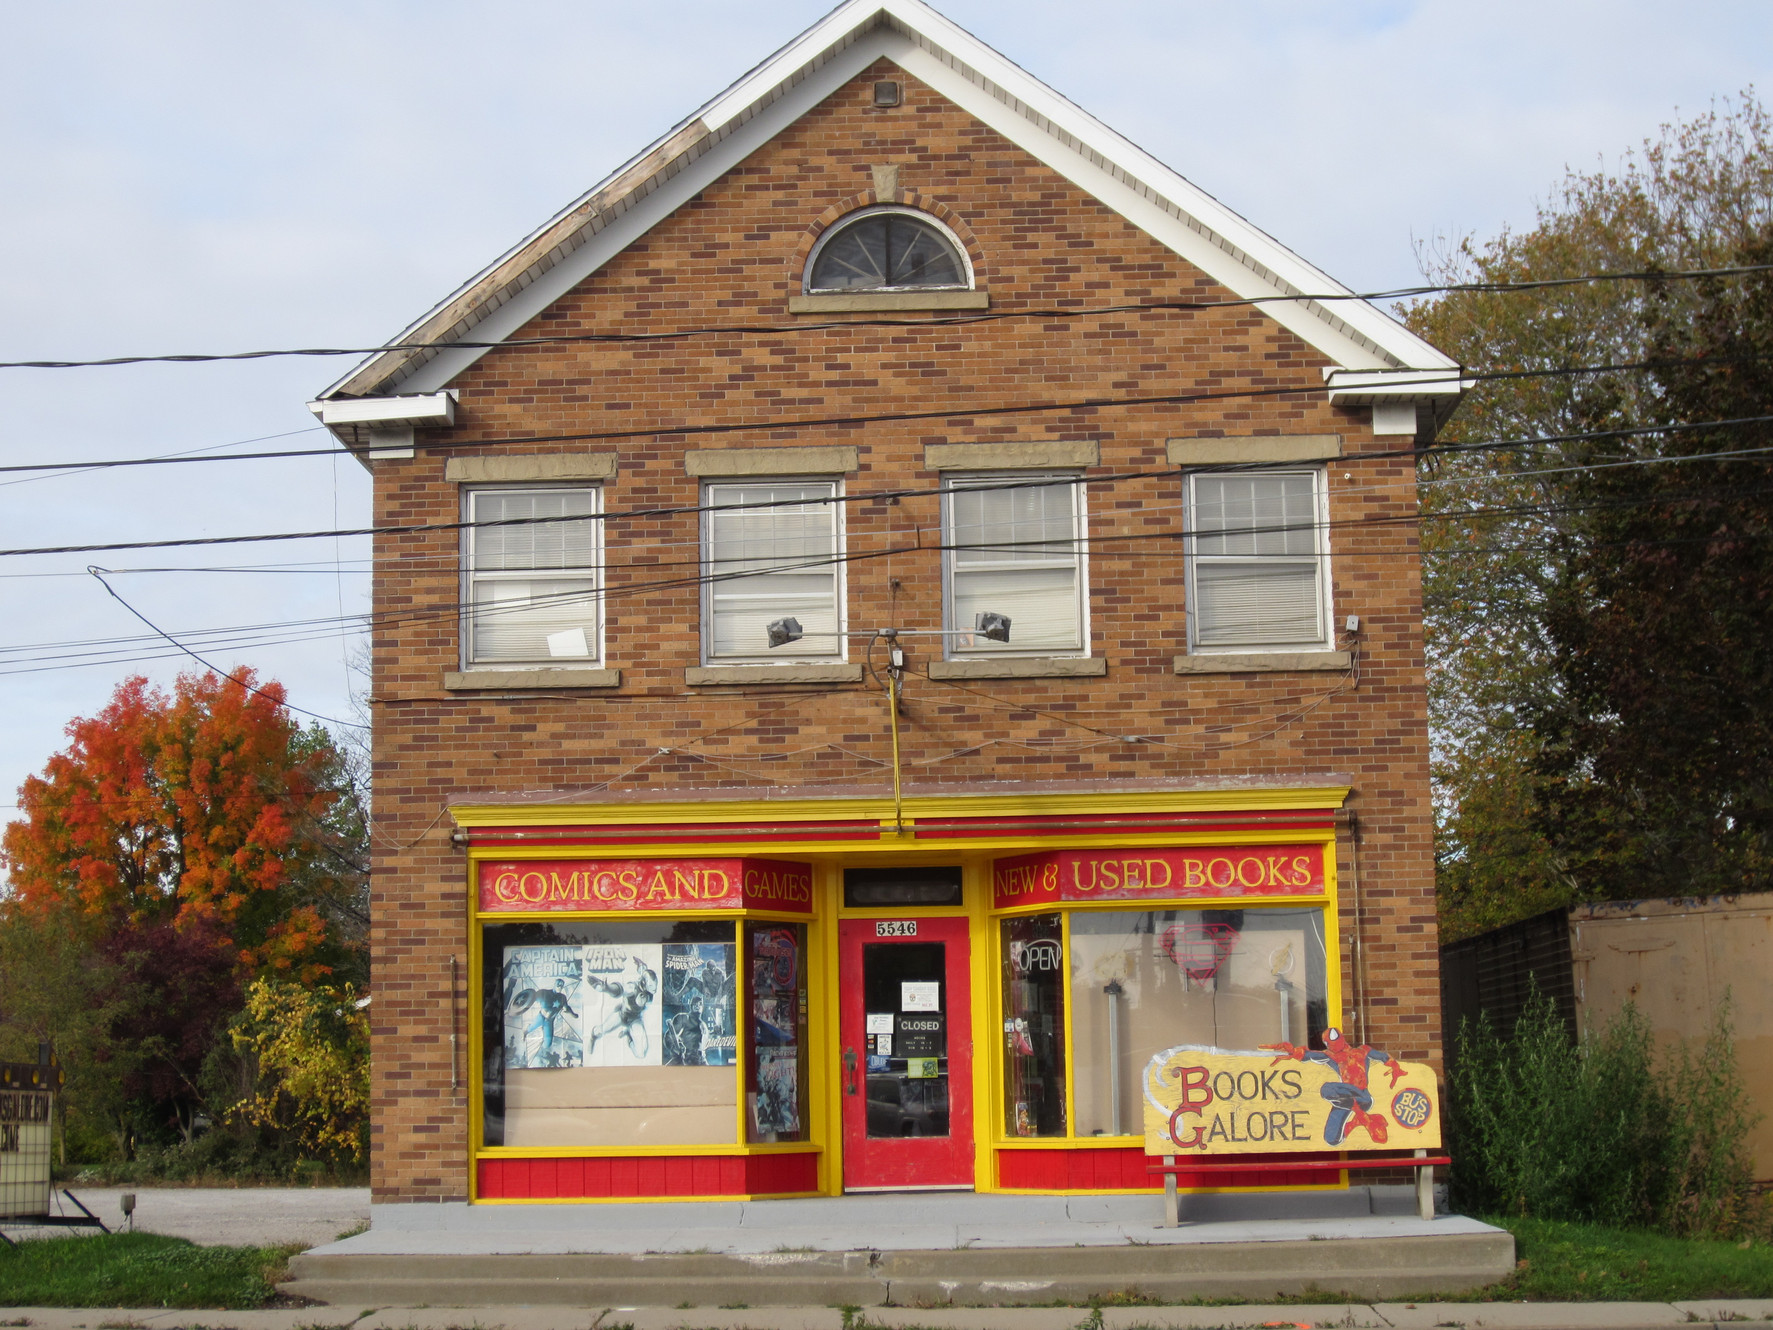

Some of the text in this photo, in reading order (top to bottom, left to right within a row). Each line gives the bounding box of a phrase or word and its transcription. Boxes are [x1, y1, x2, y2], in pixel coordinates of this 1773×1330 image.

[495, 869, 809, 903] COMICS AND GAMES
[996, 856, 1312, 897] NEW & USED BOOKS
[877, 922, 917, 935] 5546
[511, 949, 574, 963] CAPTAIN
[585, 948, 627, 961] IRON
[1020, 946, 1059, 970] OPEN
[508, 962, 579, 978] AMERICA
[588, 958, 625, 974] MAN
[901, 1021, 939, 1031] CLOSED
[1172, 1066, 1302, 1108] BOOKS
[1400, 1092, 1428, 1113] BUS
[1394, 1103, 1426, 1126] STOP
[1169, 1106, 1311, 1150] GALORE
